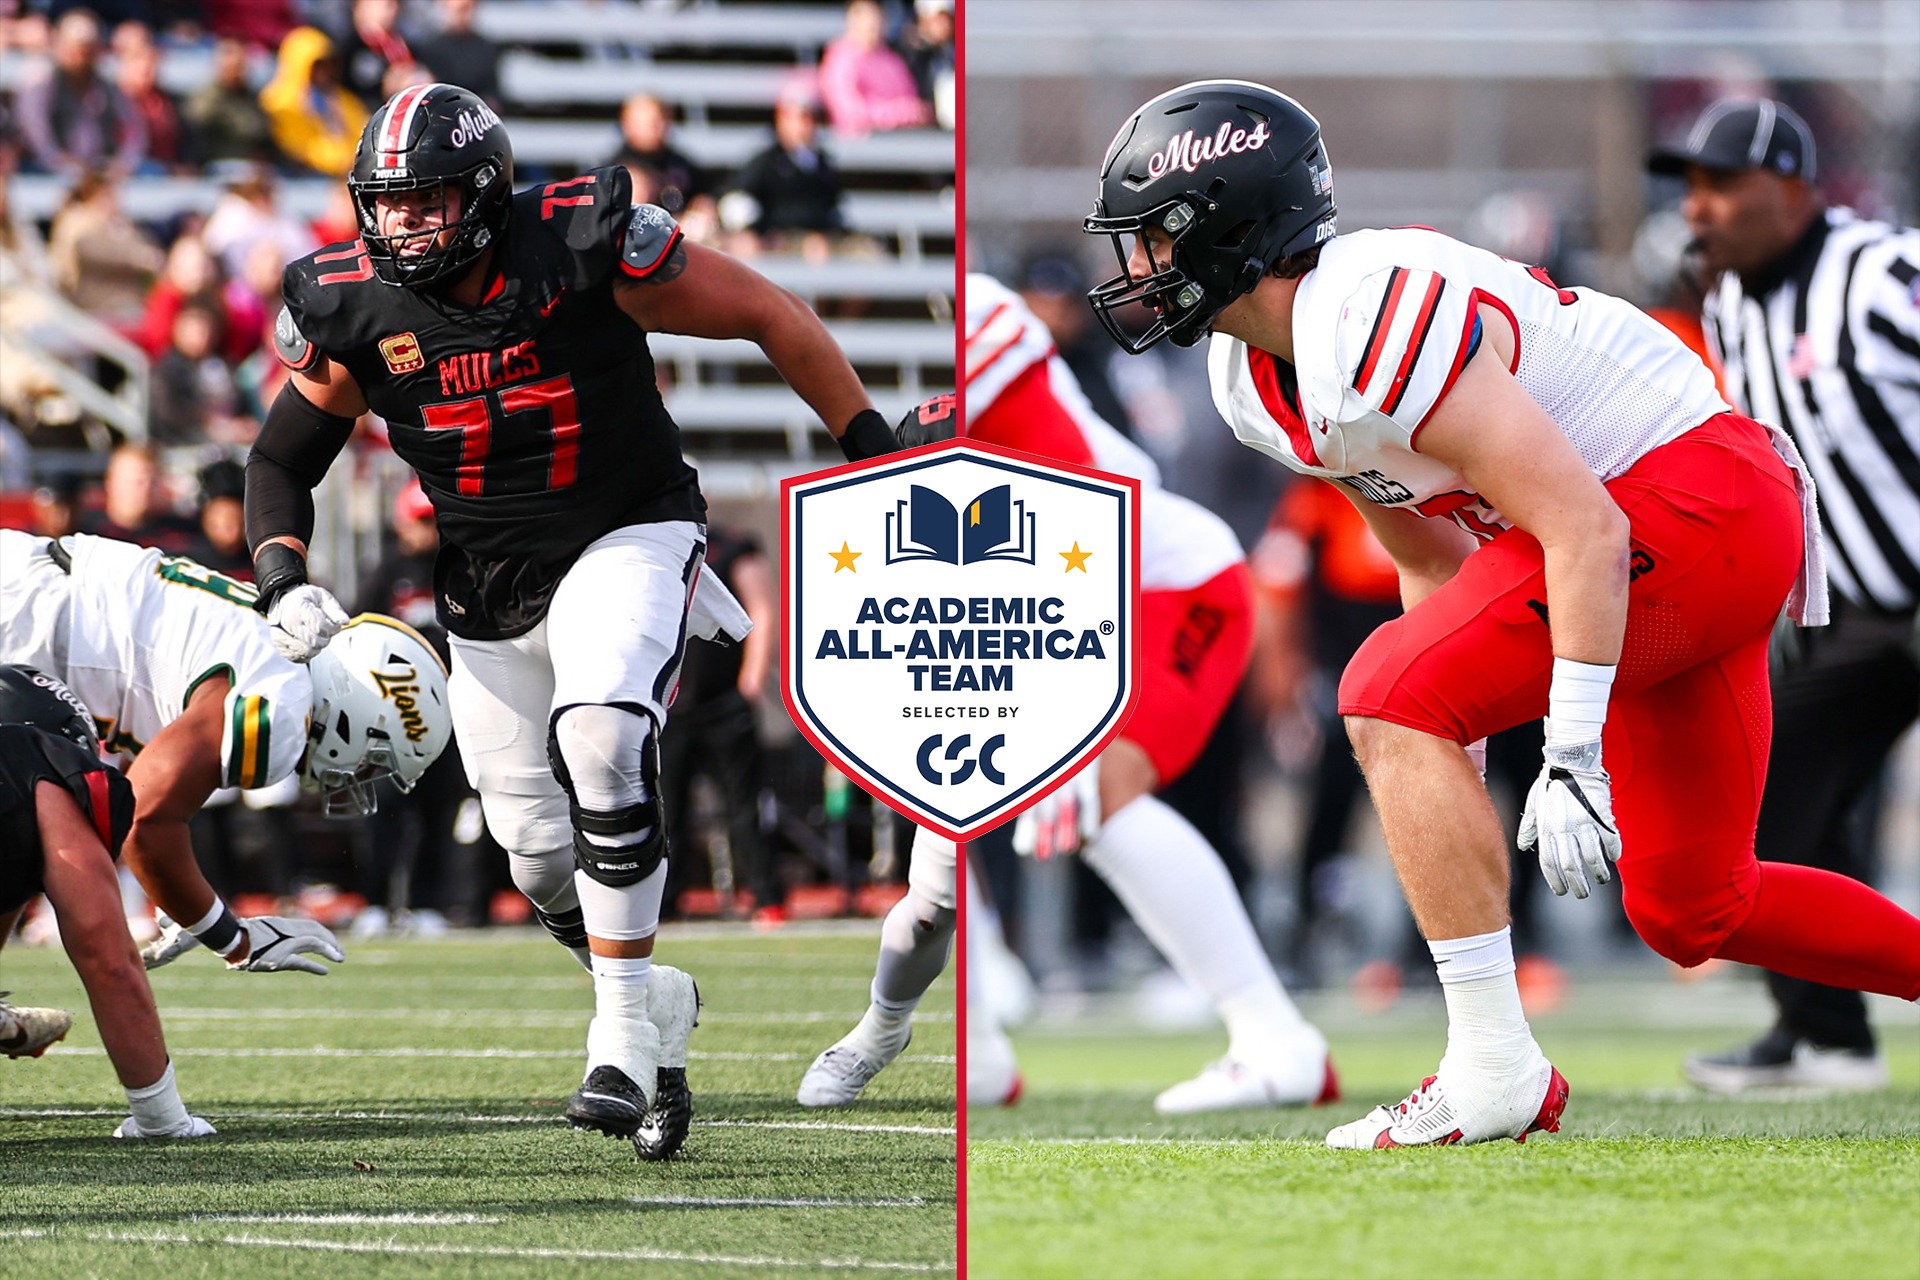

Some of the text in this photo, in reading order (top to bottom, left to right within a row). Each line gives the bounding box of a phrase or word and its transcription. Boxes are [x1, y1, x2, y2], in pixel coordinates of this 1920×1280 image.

[1148, 120, 1271, 180] Mules
[437, 339, 541, 396] MULES
[418, 372, 582, 498] 77
[370, 667, 429, 742] Lions
